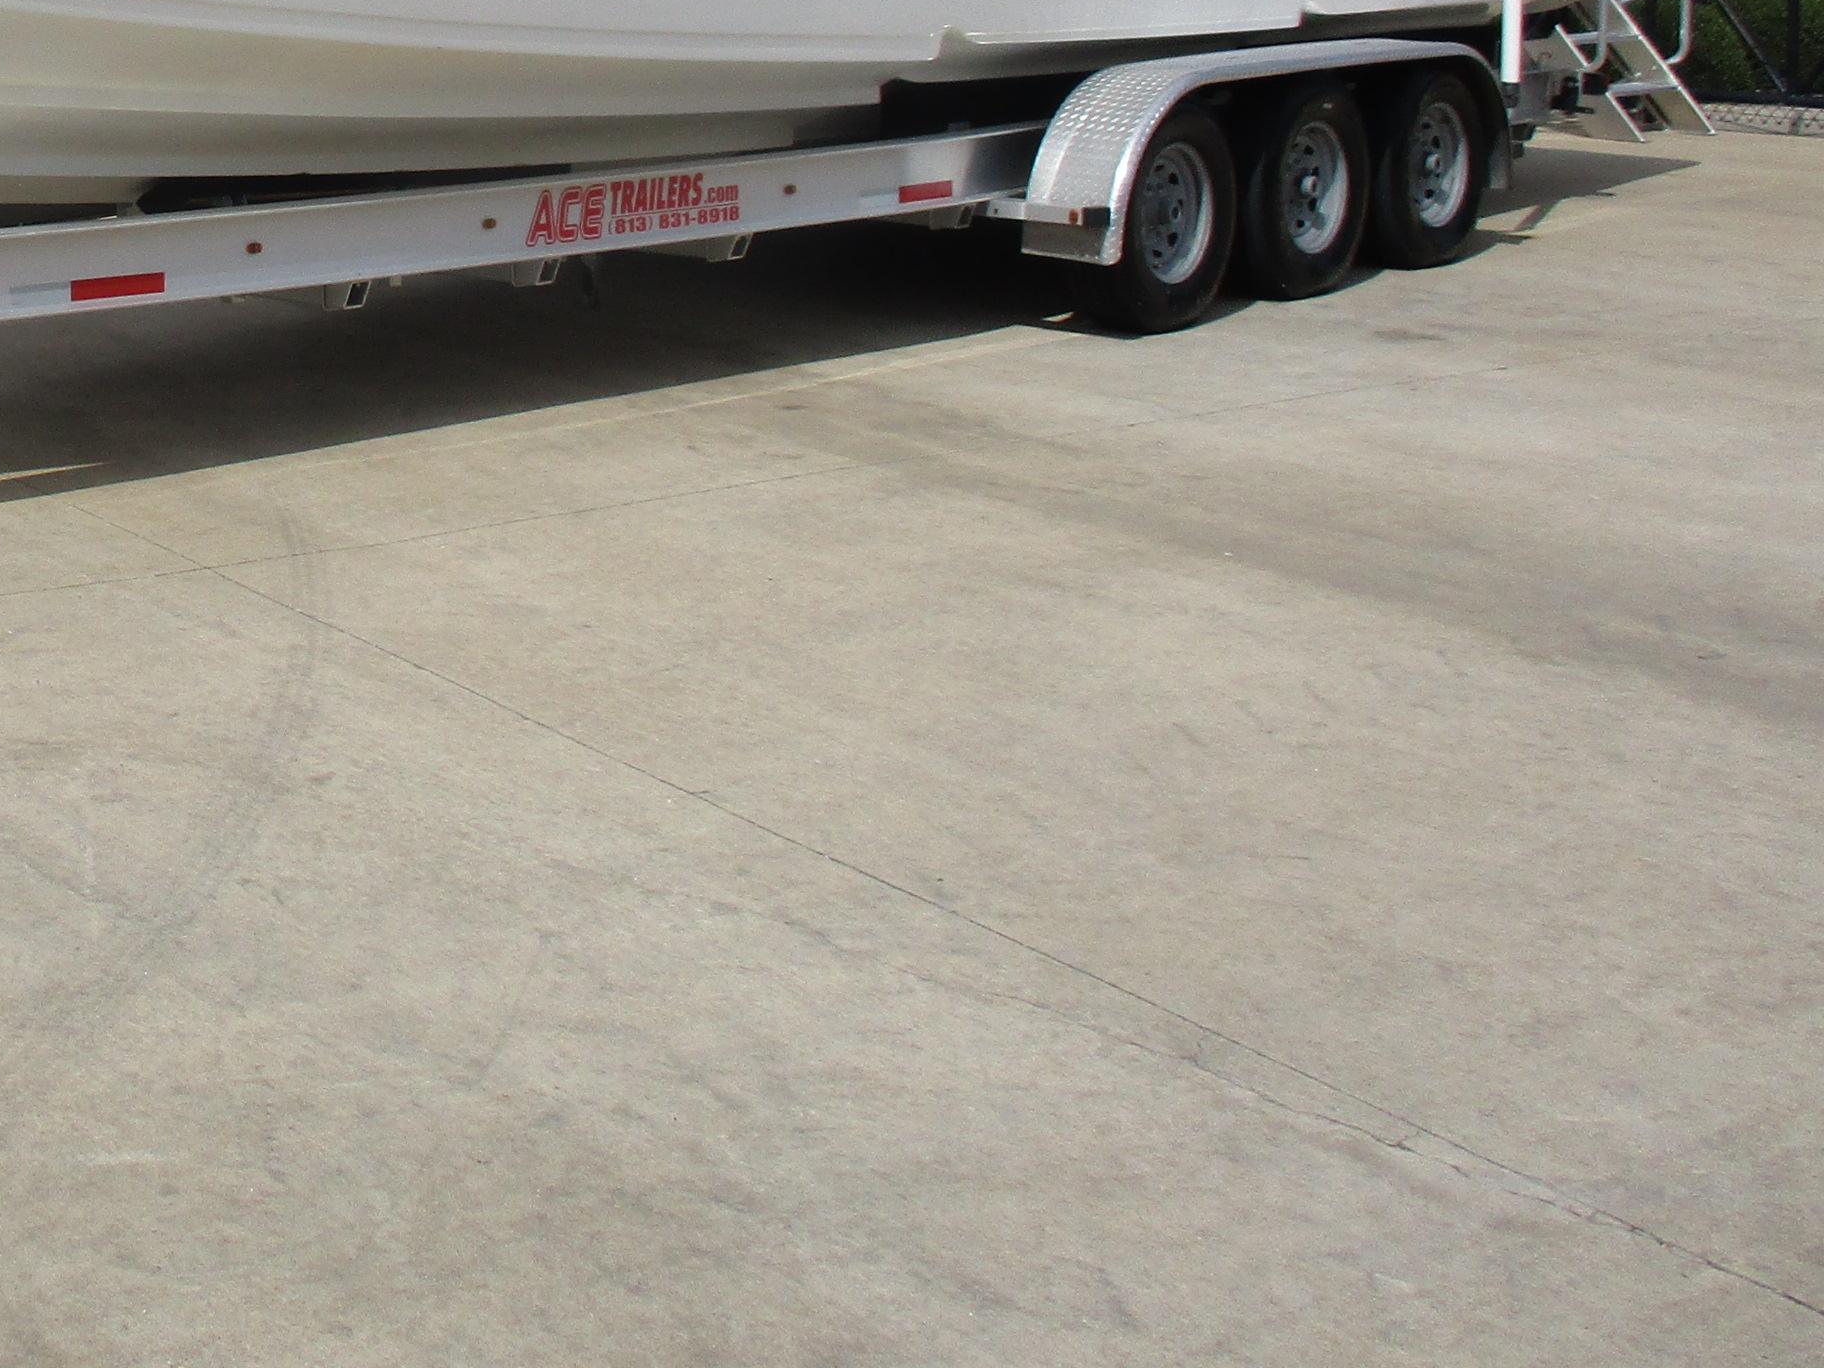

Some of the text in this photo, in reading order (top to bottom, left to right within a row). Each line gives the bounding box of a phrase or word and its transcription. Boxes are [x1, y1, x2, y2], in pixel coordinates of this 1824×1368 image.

[525, 183, 606, 247] ACE
[608, 206, 739, 235] (813) 831-8918
